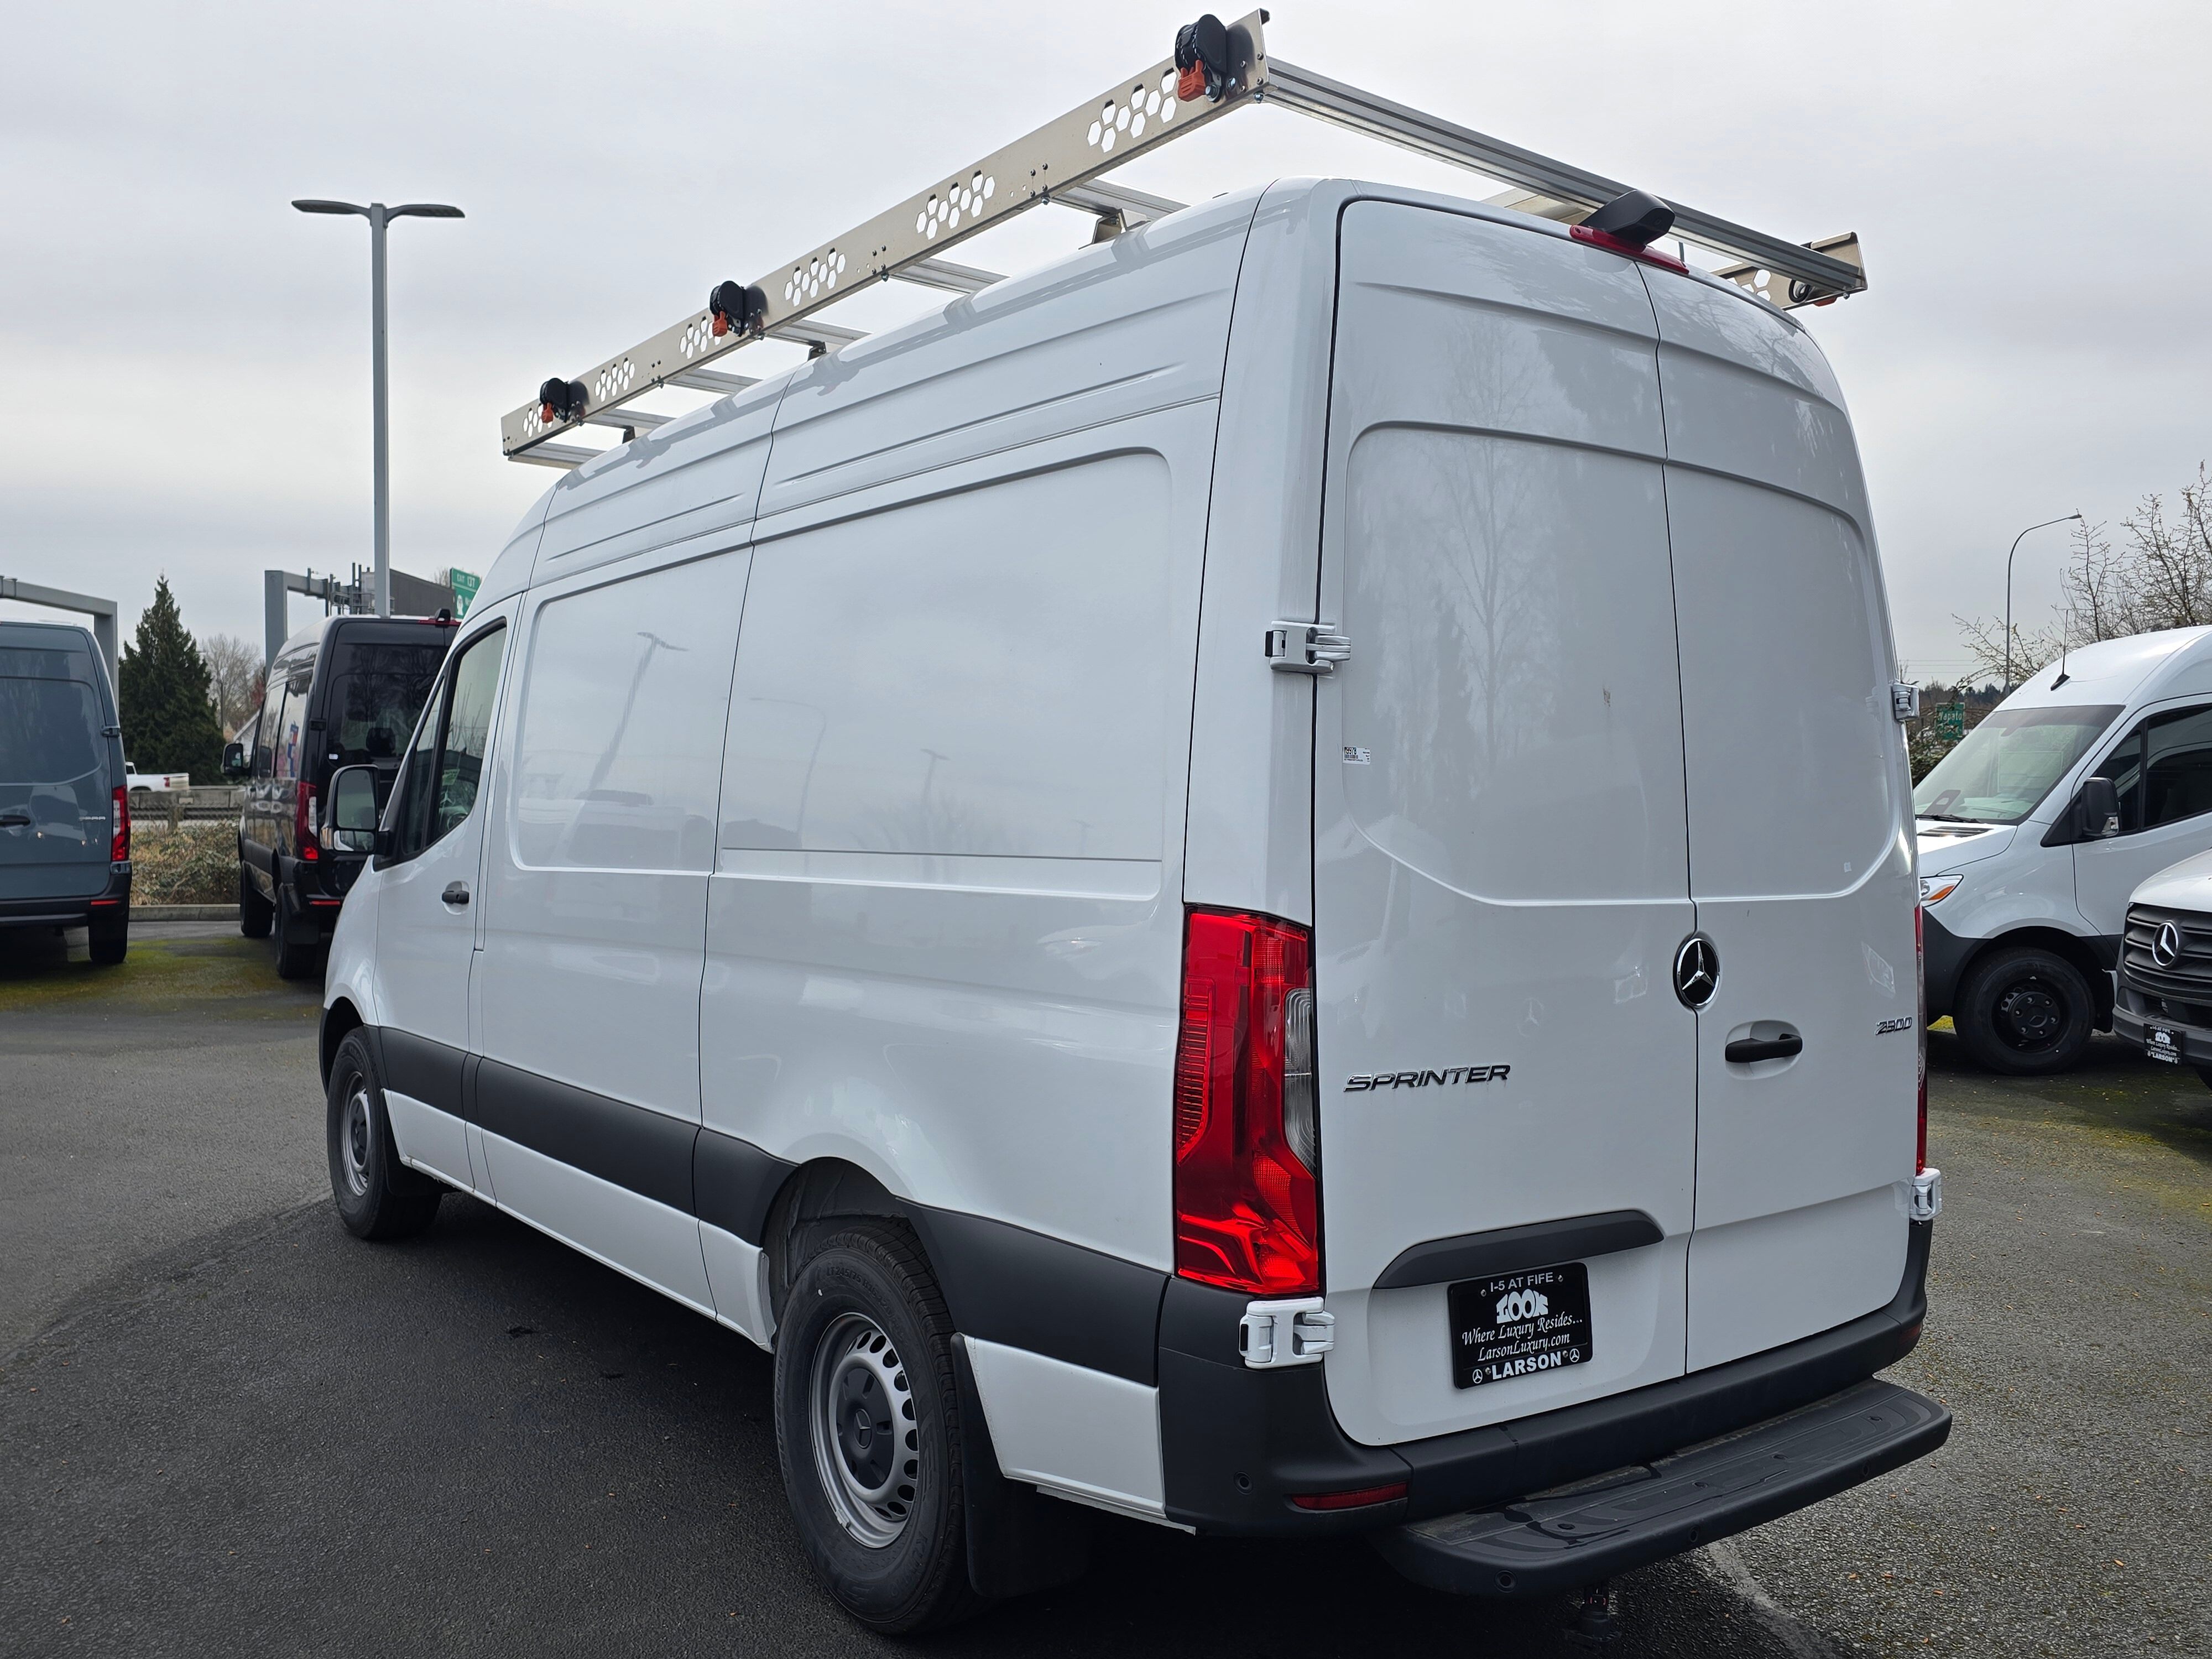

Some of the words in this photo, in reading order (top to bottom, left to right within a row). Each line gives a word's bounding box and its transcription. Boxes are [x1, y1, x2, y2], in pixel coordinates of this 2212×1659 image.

[1875, 1016, 1913, 1035] 2500
[1343, 1063, 1511, 1092] SPRINTER
[1490, 1280, 1505, 1292] I-5
[1508, 1276, 1524, 1289] AT
[1527, 1272, 1554, 1286] FIFE
[1462, 1328, 1495, 1345] Where
[1498, 1322, 1534, 1340] Luxury
[1478, 1333, 1570, 1362] LarsonLuxury.com
[1491, 1351, 1562, 1380] LARSON
